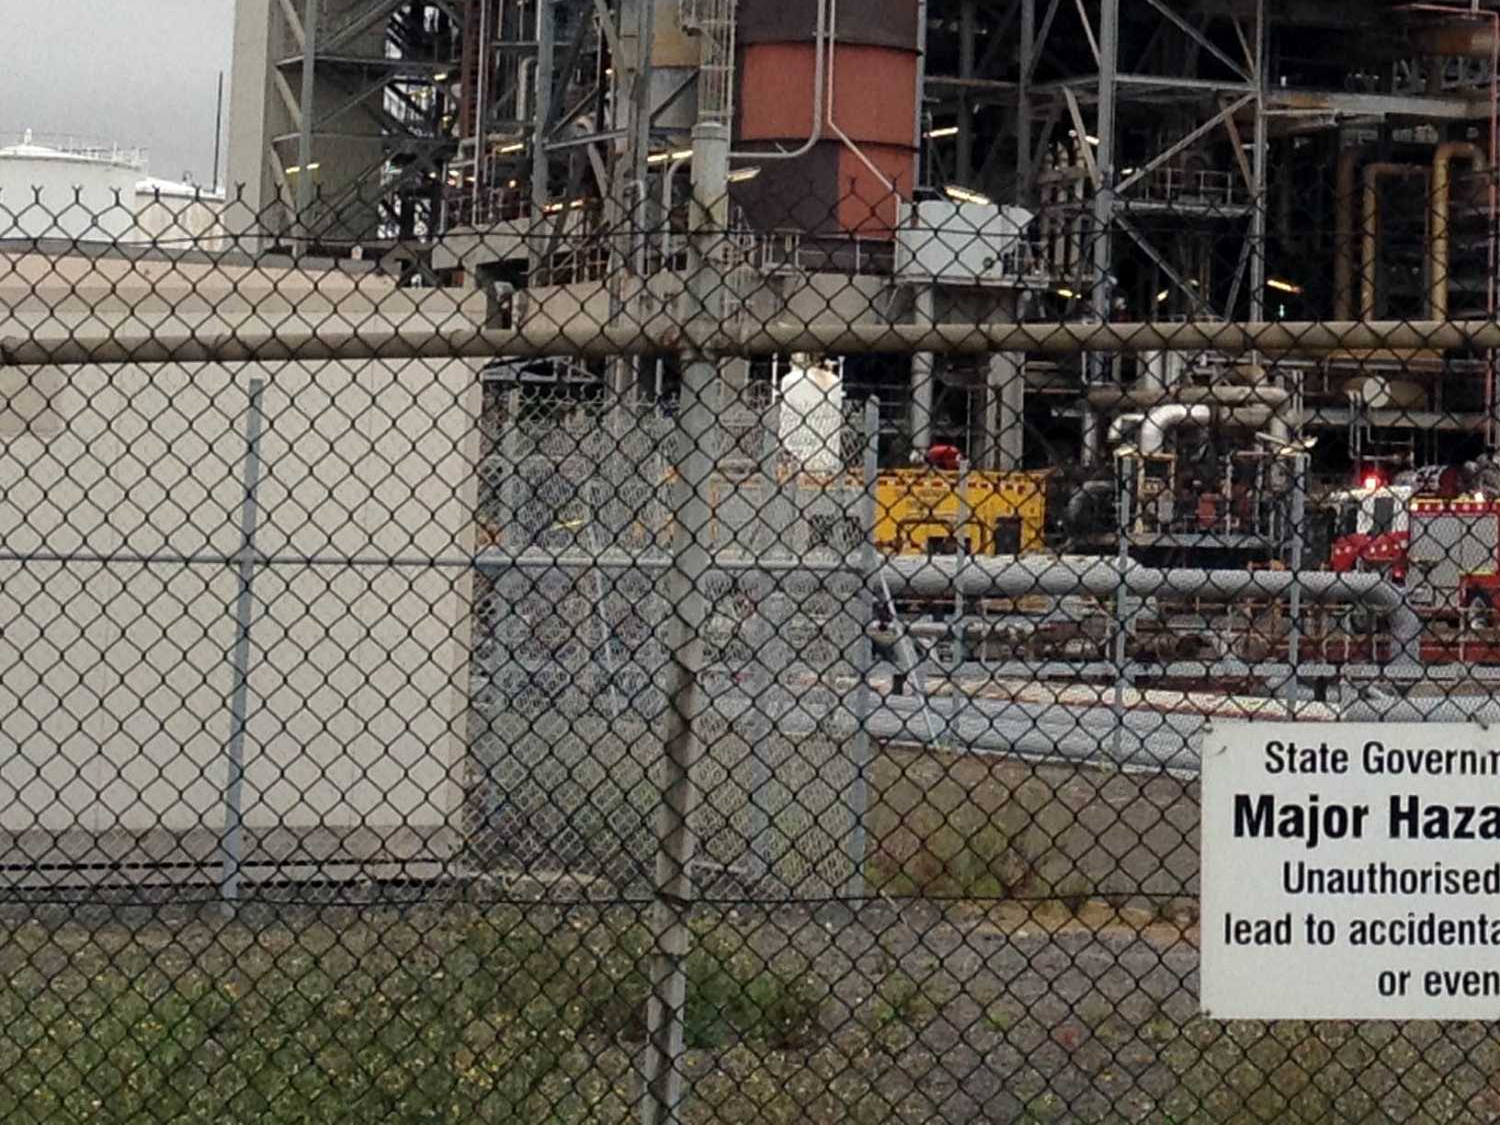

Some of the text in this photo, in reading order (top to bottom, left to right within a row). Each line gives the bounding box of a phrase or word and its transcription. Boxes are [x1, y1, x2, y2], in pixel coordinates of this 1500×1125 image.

[1265, 741, 1348, 774] State
[1233, 794, 1369, 849] Major
[1283, 862, 1500, 895] Unauthorised
[1225, 913, 1291, 945] lead
[1306, 914, 1335, 945] to
[1378, 970, 1411, 997] or
[1425, 970, 1500, 997] even
